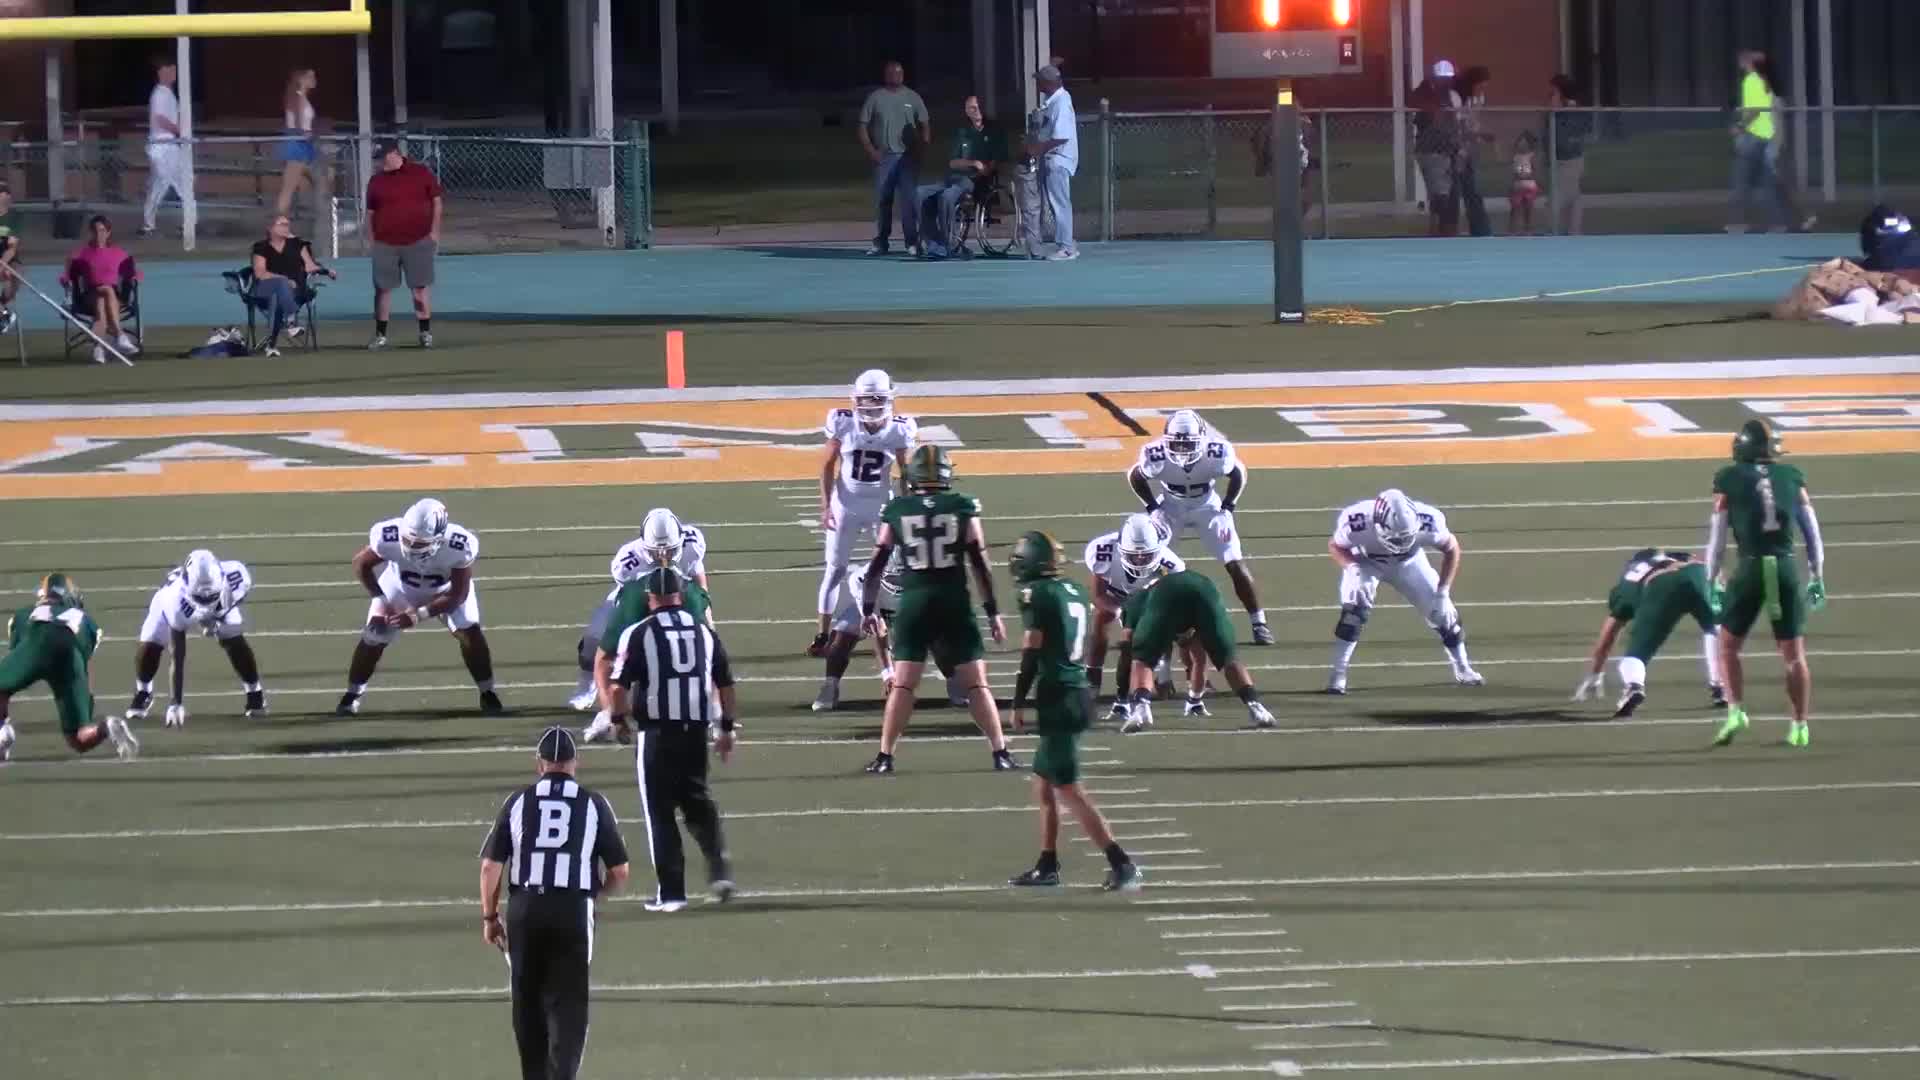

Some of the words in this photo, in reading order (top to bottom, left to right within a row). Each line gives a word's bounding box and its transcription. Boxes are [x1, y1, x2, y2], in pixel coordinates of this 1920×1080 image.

[1207, 441, 1224, 459] 23
[851, 449, 886, 482] 12
[1755, 478, 1781, 531] 1
[382, 525, 399, 542] 63
[1348, 513, 1366, 532] 53
[449, 532, 468, 551] 63
[901, 513, 961, 570] 52
[1095, 544, 1114, 562] 56
[619, 551, 641, 572] 72
[1066, 602, 1086, 662] 7
[665, 630, 696, 673] U
[535, 800, 572, 849] B
